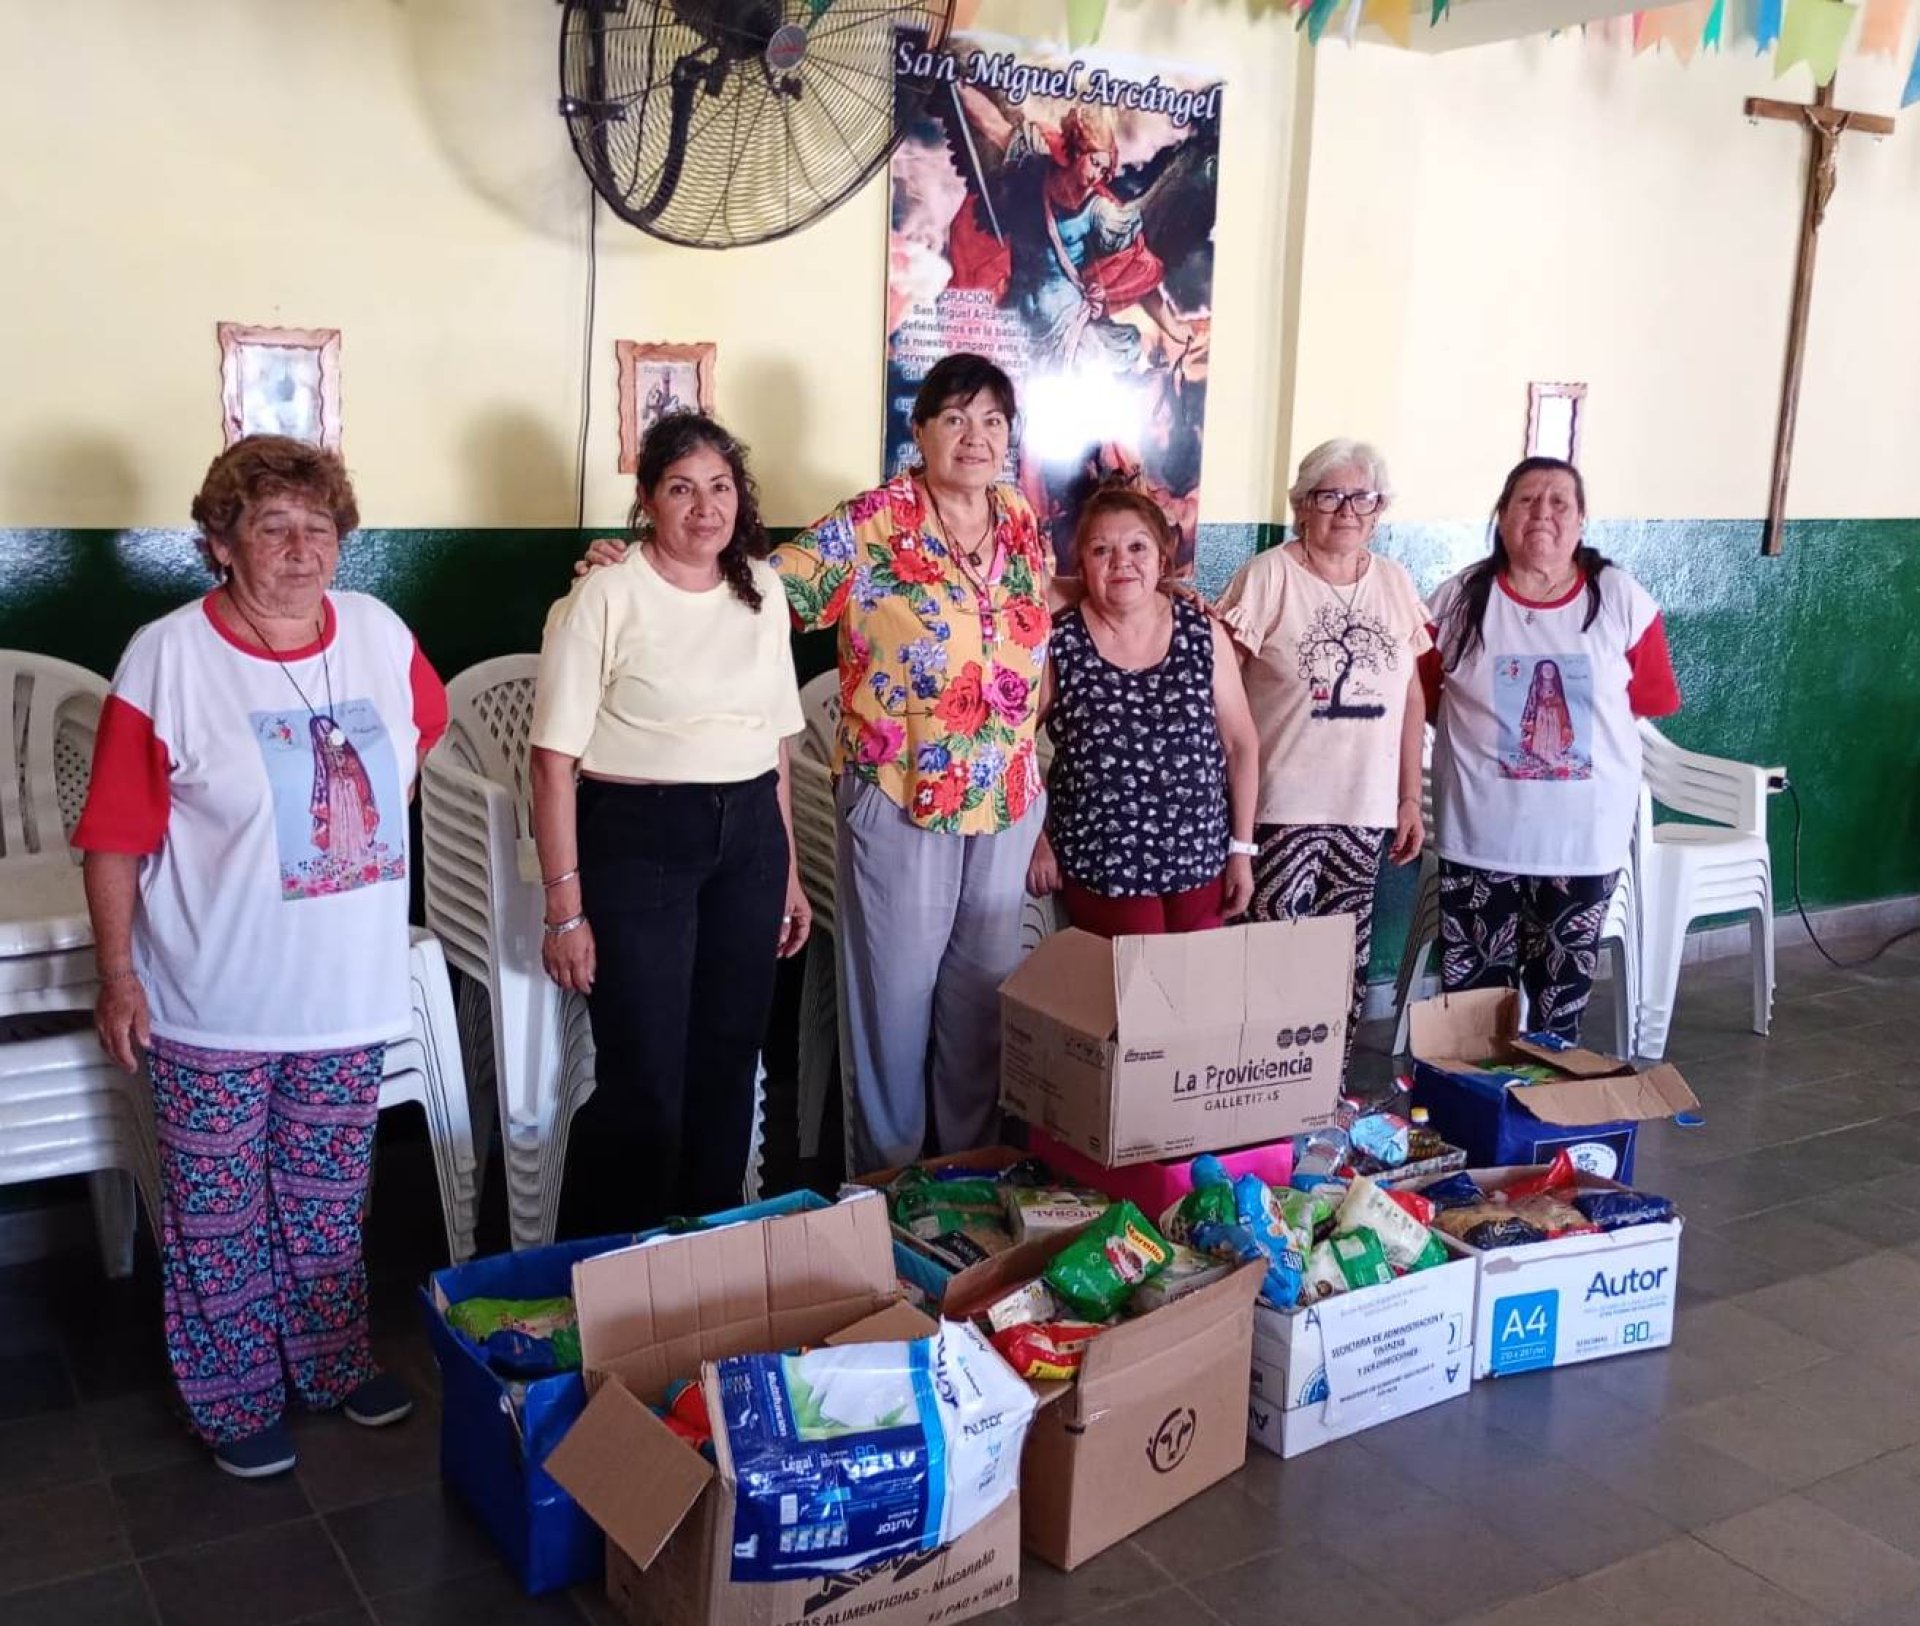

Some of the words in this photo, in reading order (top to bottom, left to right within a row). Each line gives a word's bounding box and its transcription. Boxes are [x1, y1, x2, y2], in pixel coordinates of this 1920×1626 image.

[895, 40, 956, 83] San
[965, 50, 1083, 104] Miguel
[1083, 71, 1217, 127] Arcángel
[912, 303, 934, 316] San
[936, 305, 971, 319] Miguel
[912, 337, 953, 349] nuestro
[1173, 1070, 1198, 1094] La
[1205, 1051, 1313, 1091] Providencia
[1584, 1265, 1668, 1302] Autor
[1501, 1304, 1548, 1343] A4
[1623, 1321, 1649, 1344] 80
[877, 1515, 917, 1536] Autor
